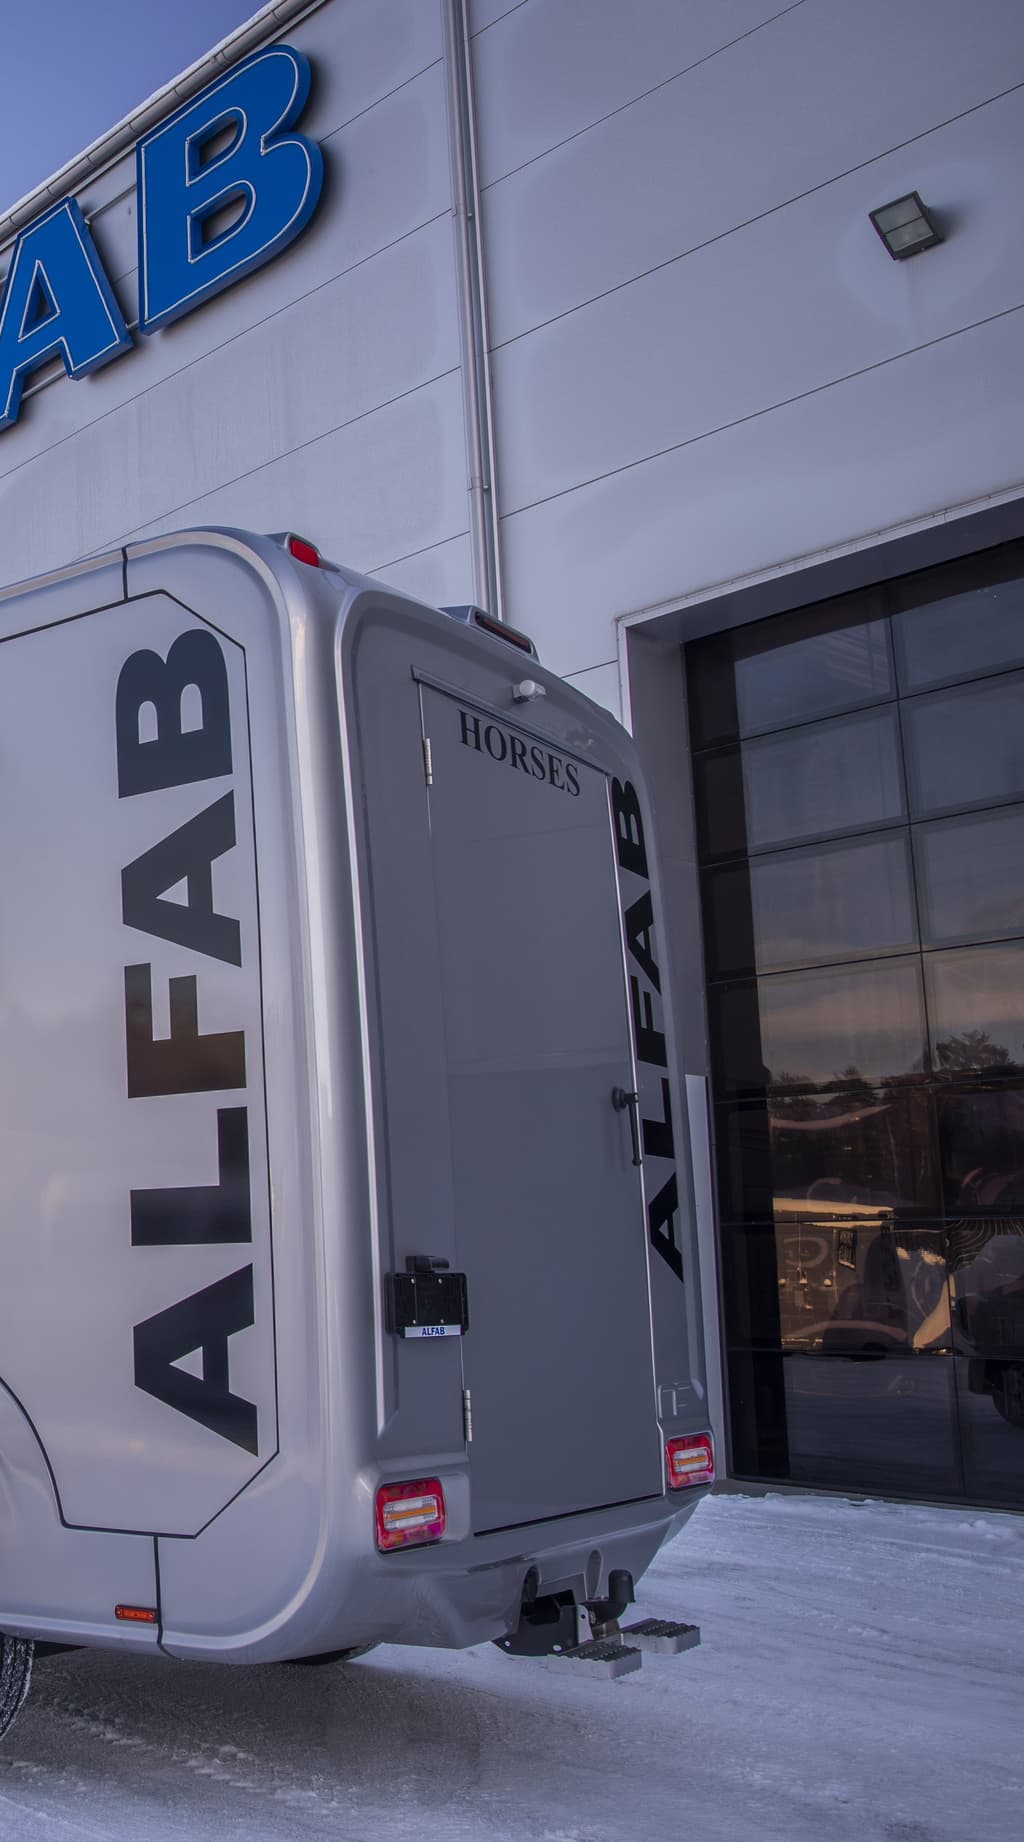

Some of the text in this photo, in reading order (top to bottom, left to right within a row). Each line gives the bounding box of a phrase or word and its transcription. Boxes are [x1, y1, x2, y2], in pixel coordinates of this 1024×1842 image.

[459, 708, 581, 797] HORSES
[115, 628, 260, 1458] ALFAB
[610, 775, 684, 1283] ALFAB
[421, 1326, 446, 1336] ALFAB
